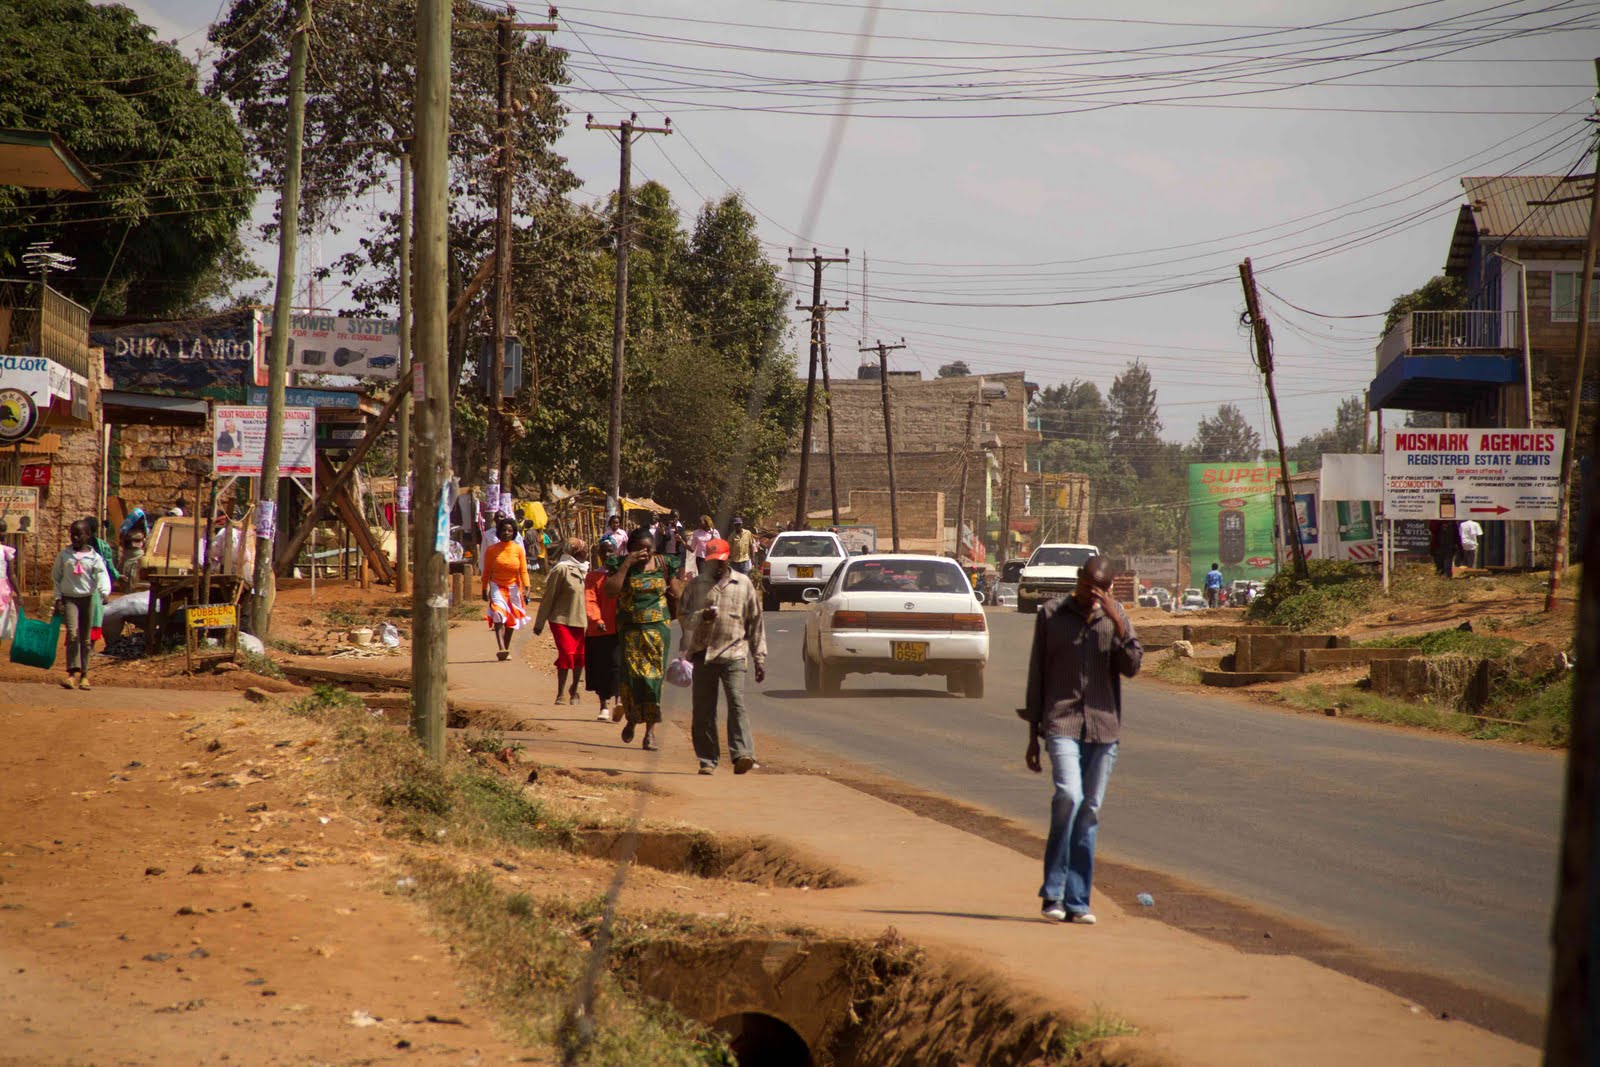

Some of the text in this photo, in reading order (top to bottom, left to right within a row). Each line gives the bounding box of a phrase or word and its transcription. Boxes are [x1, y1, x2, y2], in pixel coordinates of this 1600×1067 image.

[115, 337, 170, 359] DUKA
[178, 338, 204, 359] LA
[1395, 433, 1555, 452] MOSMARK AGENCIES
[1407, 454, 1551, 466] REGISTERED ESTATE AGENTS
[1201, 467, 1282, 484] SUPER
[203, 617, 220, 627] DEN
[896, 641, 917, 651] KAL
[896, 651, 924, 661] 059Y
